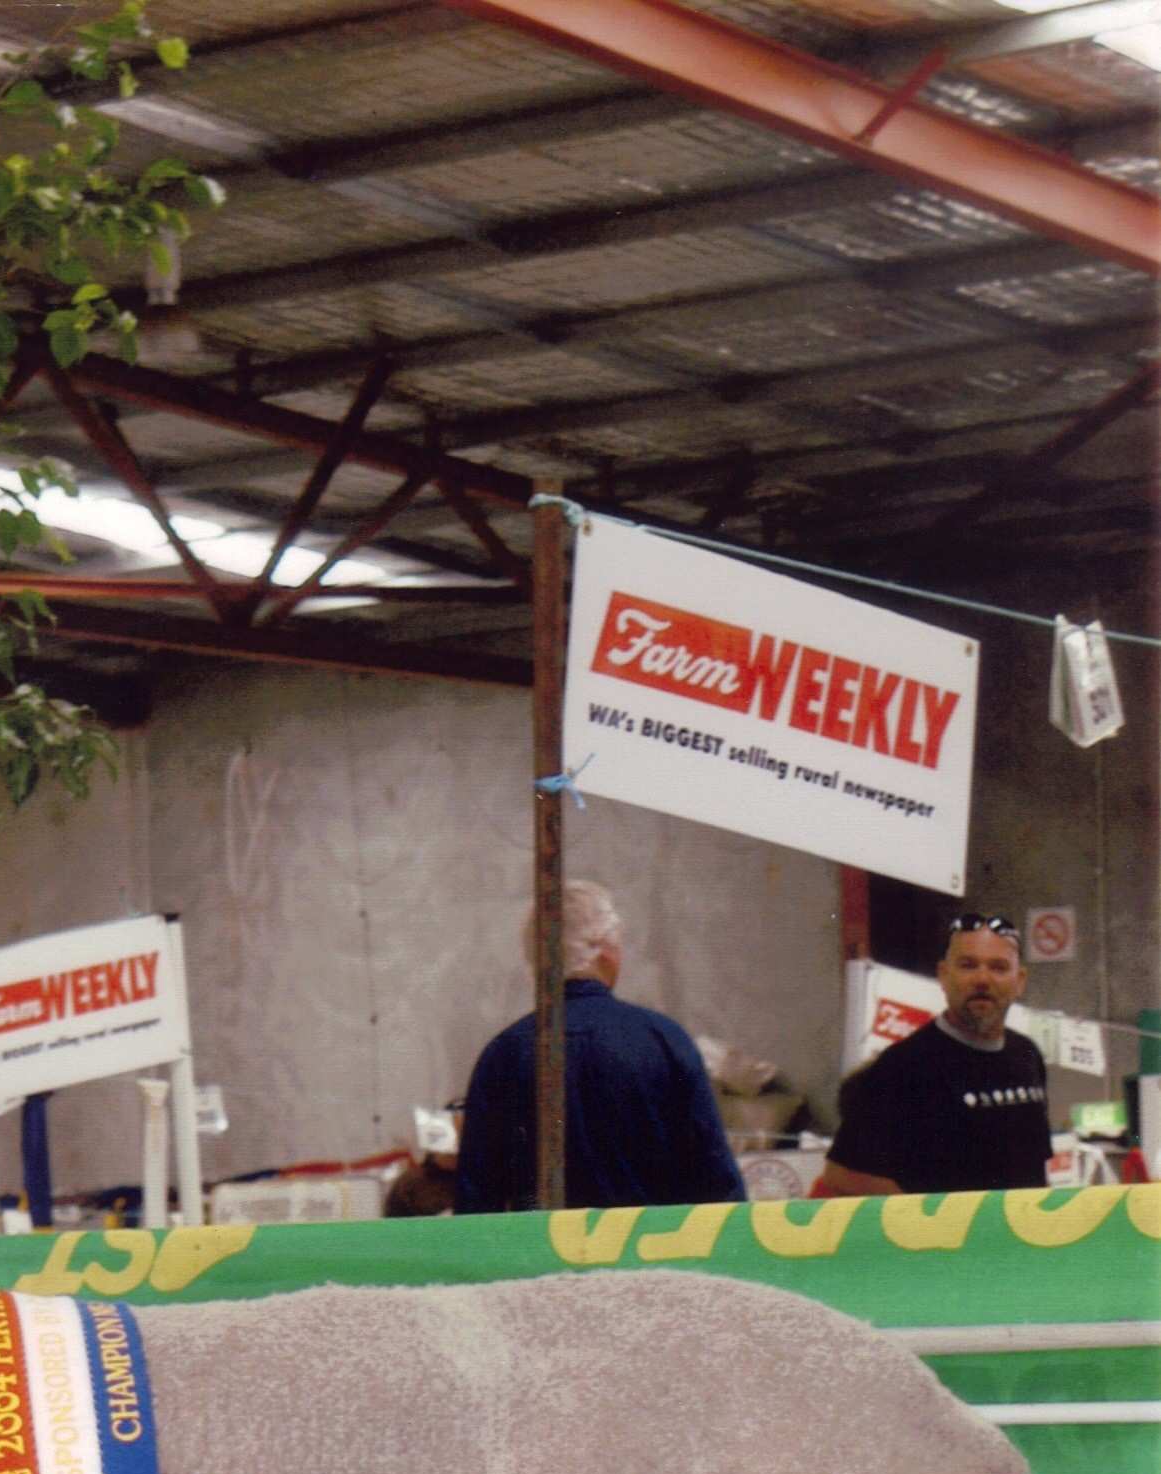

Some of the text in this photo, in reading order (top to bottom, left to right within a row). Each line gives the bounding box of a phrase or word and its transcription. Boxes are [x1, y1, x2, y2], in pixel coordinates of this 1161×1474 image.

[606, 607, 961, 772] Farm WEEKLY
[588, 702, 935, 818] WA's BIGGEST selling rural newspaper
[41, 951, 160, 1021] WEEKLY
[94, 1313, 144, 1443] CHAMPION
